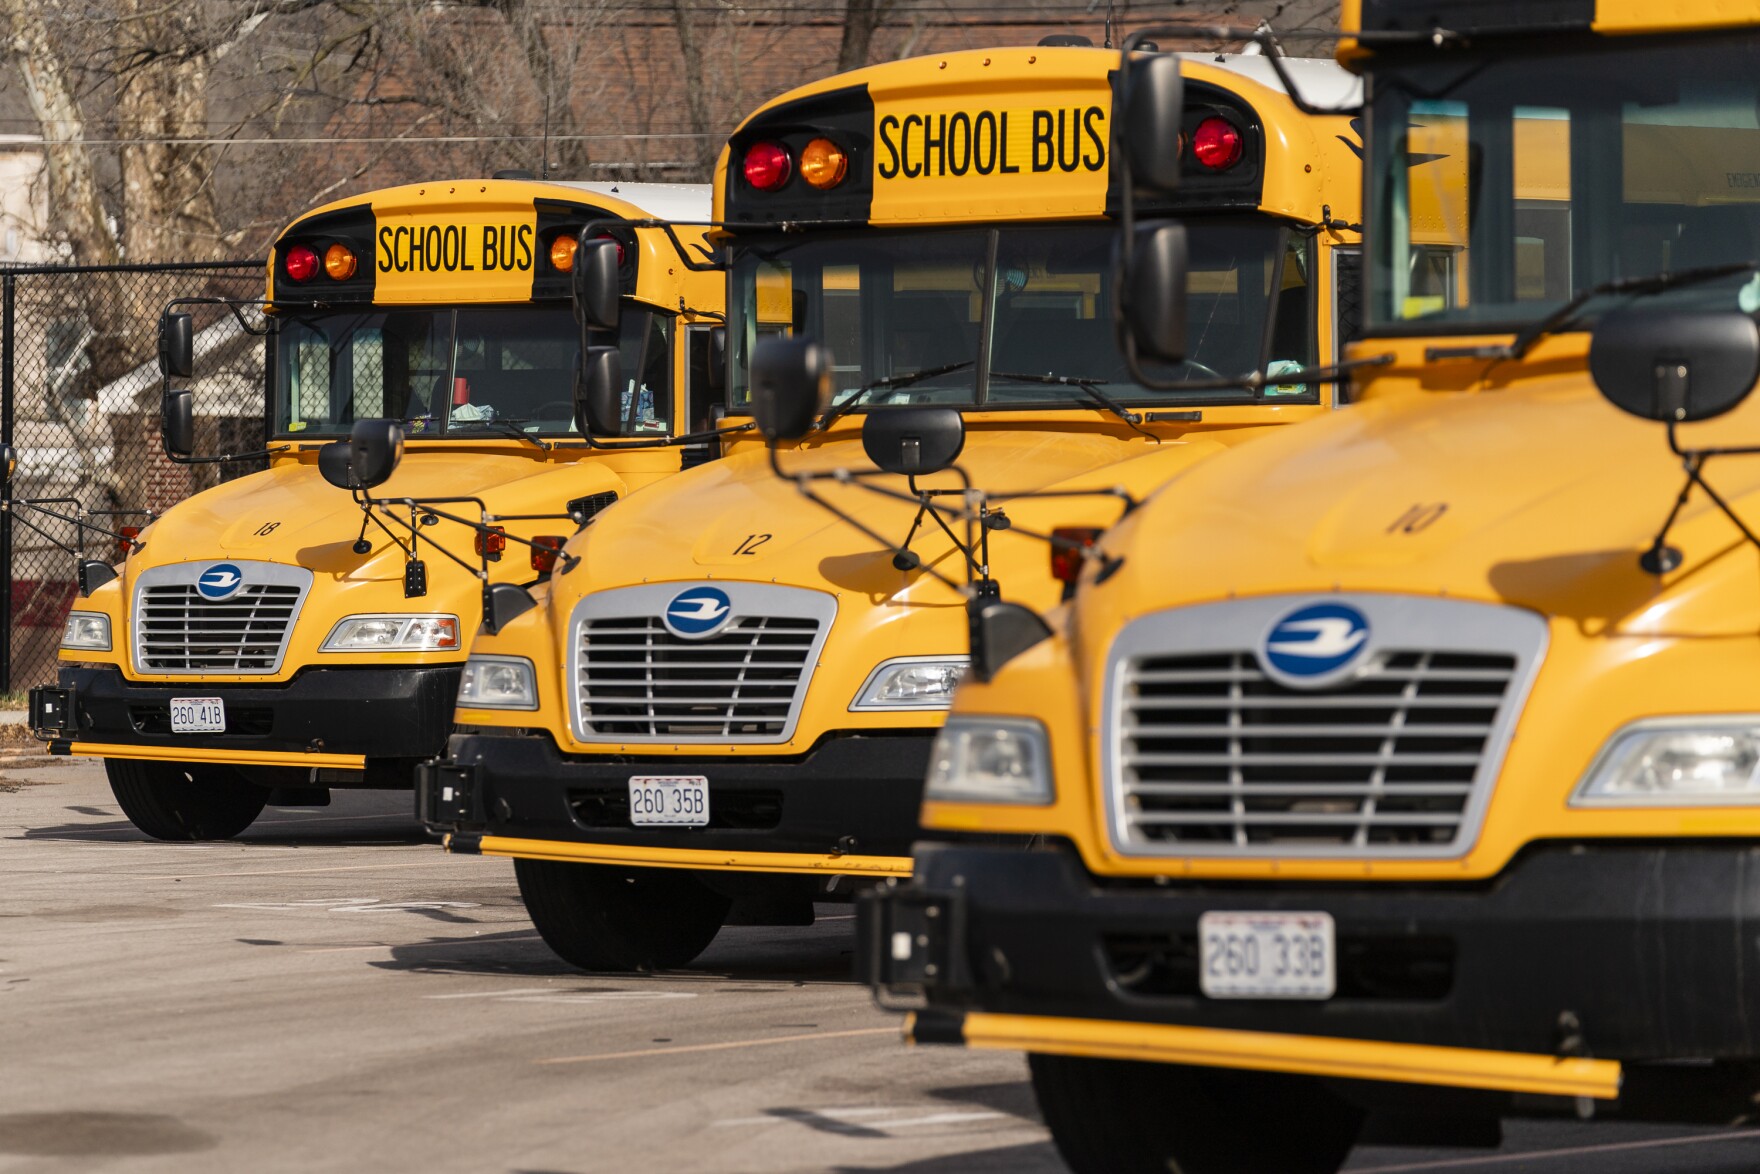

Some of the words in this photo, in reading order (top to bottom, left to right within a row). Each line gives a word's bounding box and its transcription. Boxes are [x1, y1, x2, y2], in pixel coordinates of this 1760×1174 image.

[878, 110, 1019, 179] SCHOOL
[1032, 106, 1105, 172] BUS
[378, 225, 474, 272] SCHOOL
[482, 224, 532, 271] BUS
[253, 521, 281, 536] 18
[1386, 502, 1448, 534] 10
[732, 533, 773, 555] 12
[173, 706, 194, 724] 260
[200, 706, 221, 724] 41B
[633, 788, 664, 813] 260
[672, 788, 704, 813] 35B
[1208, 933, 1260, 977] 260
